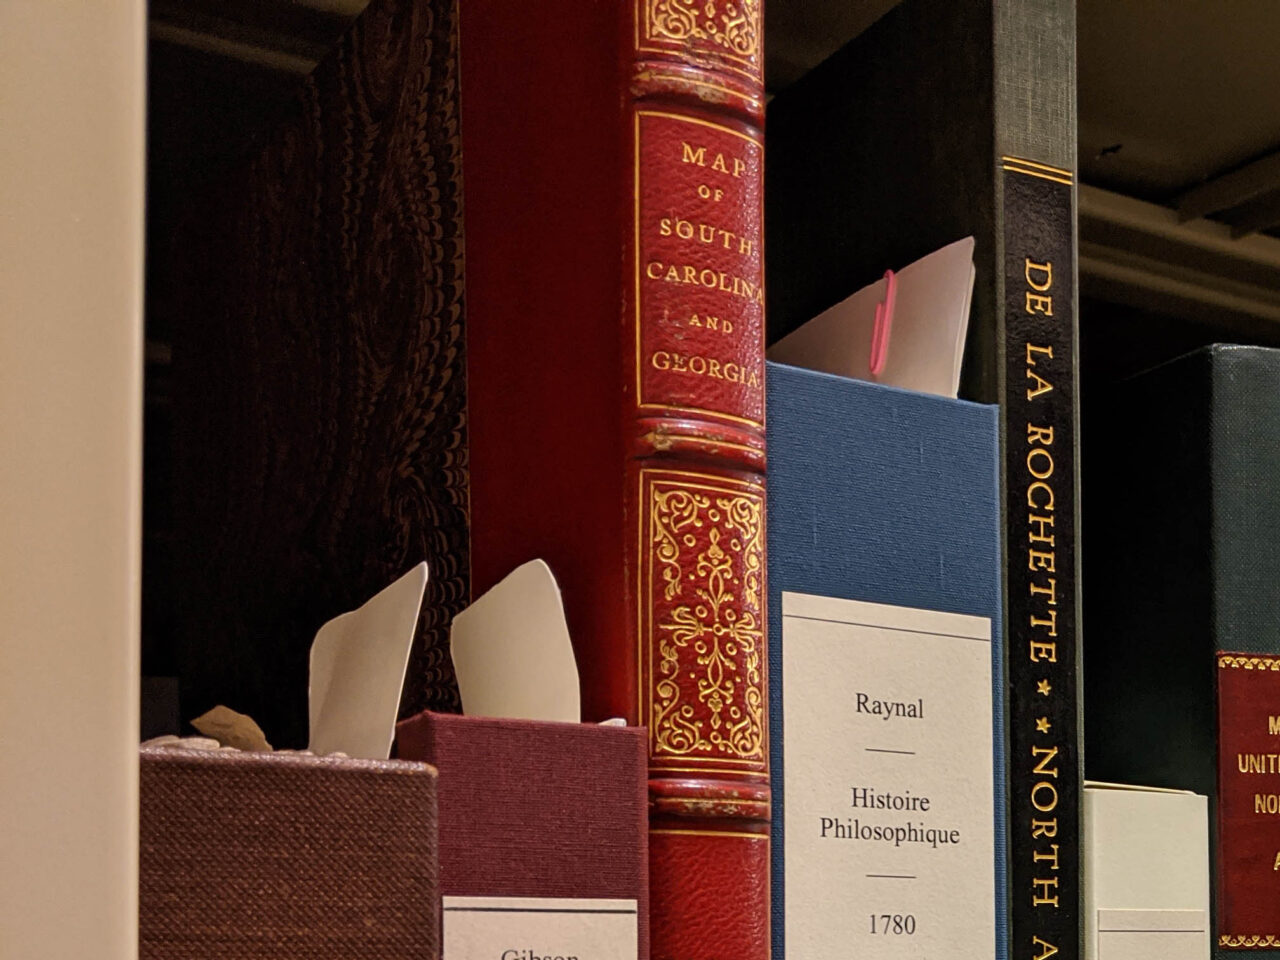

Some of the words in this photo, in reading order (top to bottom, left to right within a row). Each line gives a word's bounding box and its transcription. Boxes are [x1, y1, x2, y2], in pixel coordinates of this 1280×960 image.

[682, 142, 746, 178] MAP
[698, 184, 724, 202] OF
[660, 218, 753, 255] SOUTH
[647, 262, 763, 305] CAROLINA
[1025, 258, 1053, 317] DE
[689, 314, 734, 334] AND
[652, 351, 758, 388] GEORGIA
[1026, 342, 1054, 402] LA
[1027, 422, 1057, 664] ROCHETTE
[855, 692, 924, 721] Raynal
[850, 787, 930, 812] Histoire
[820, 818, 960, 848] Philosophique
[1031, 746, 1059, 908] NORTH
[869, 914, 916, 935] 1780
